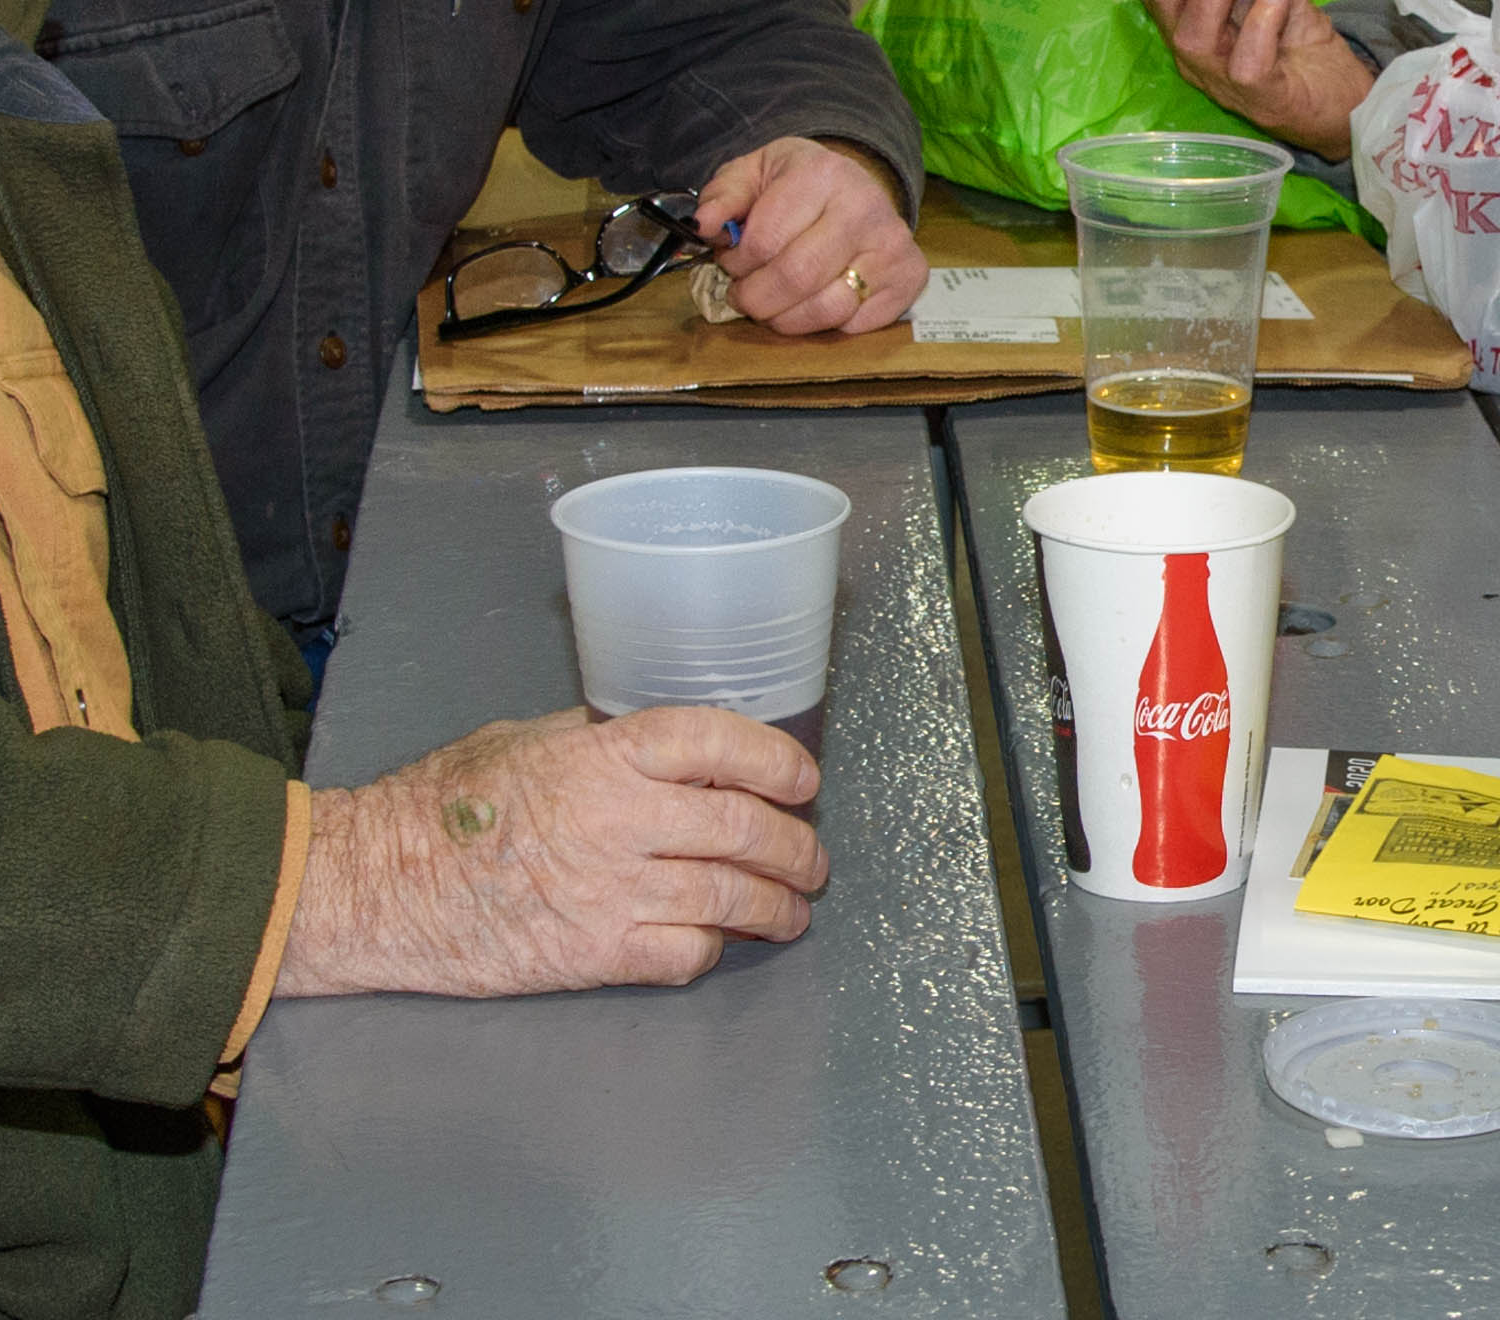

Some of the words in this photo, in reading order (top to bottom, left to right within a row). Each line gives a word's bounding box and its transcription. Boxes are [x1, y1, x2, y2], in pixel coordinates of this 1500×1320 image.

[1136, 689, 1230, 742] Coca-Cola
[1345, 757, 1377, 789] 2020
[1354, 897, 1416, 915] Door
[1424, 895, 1498, 917] Great
